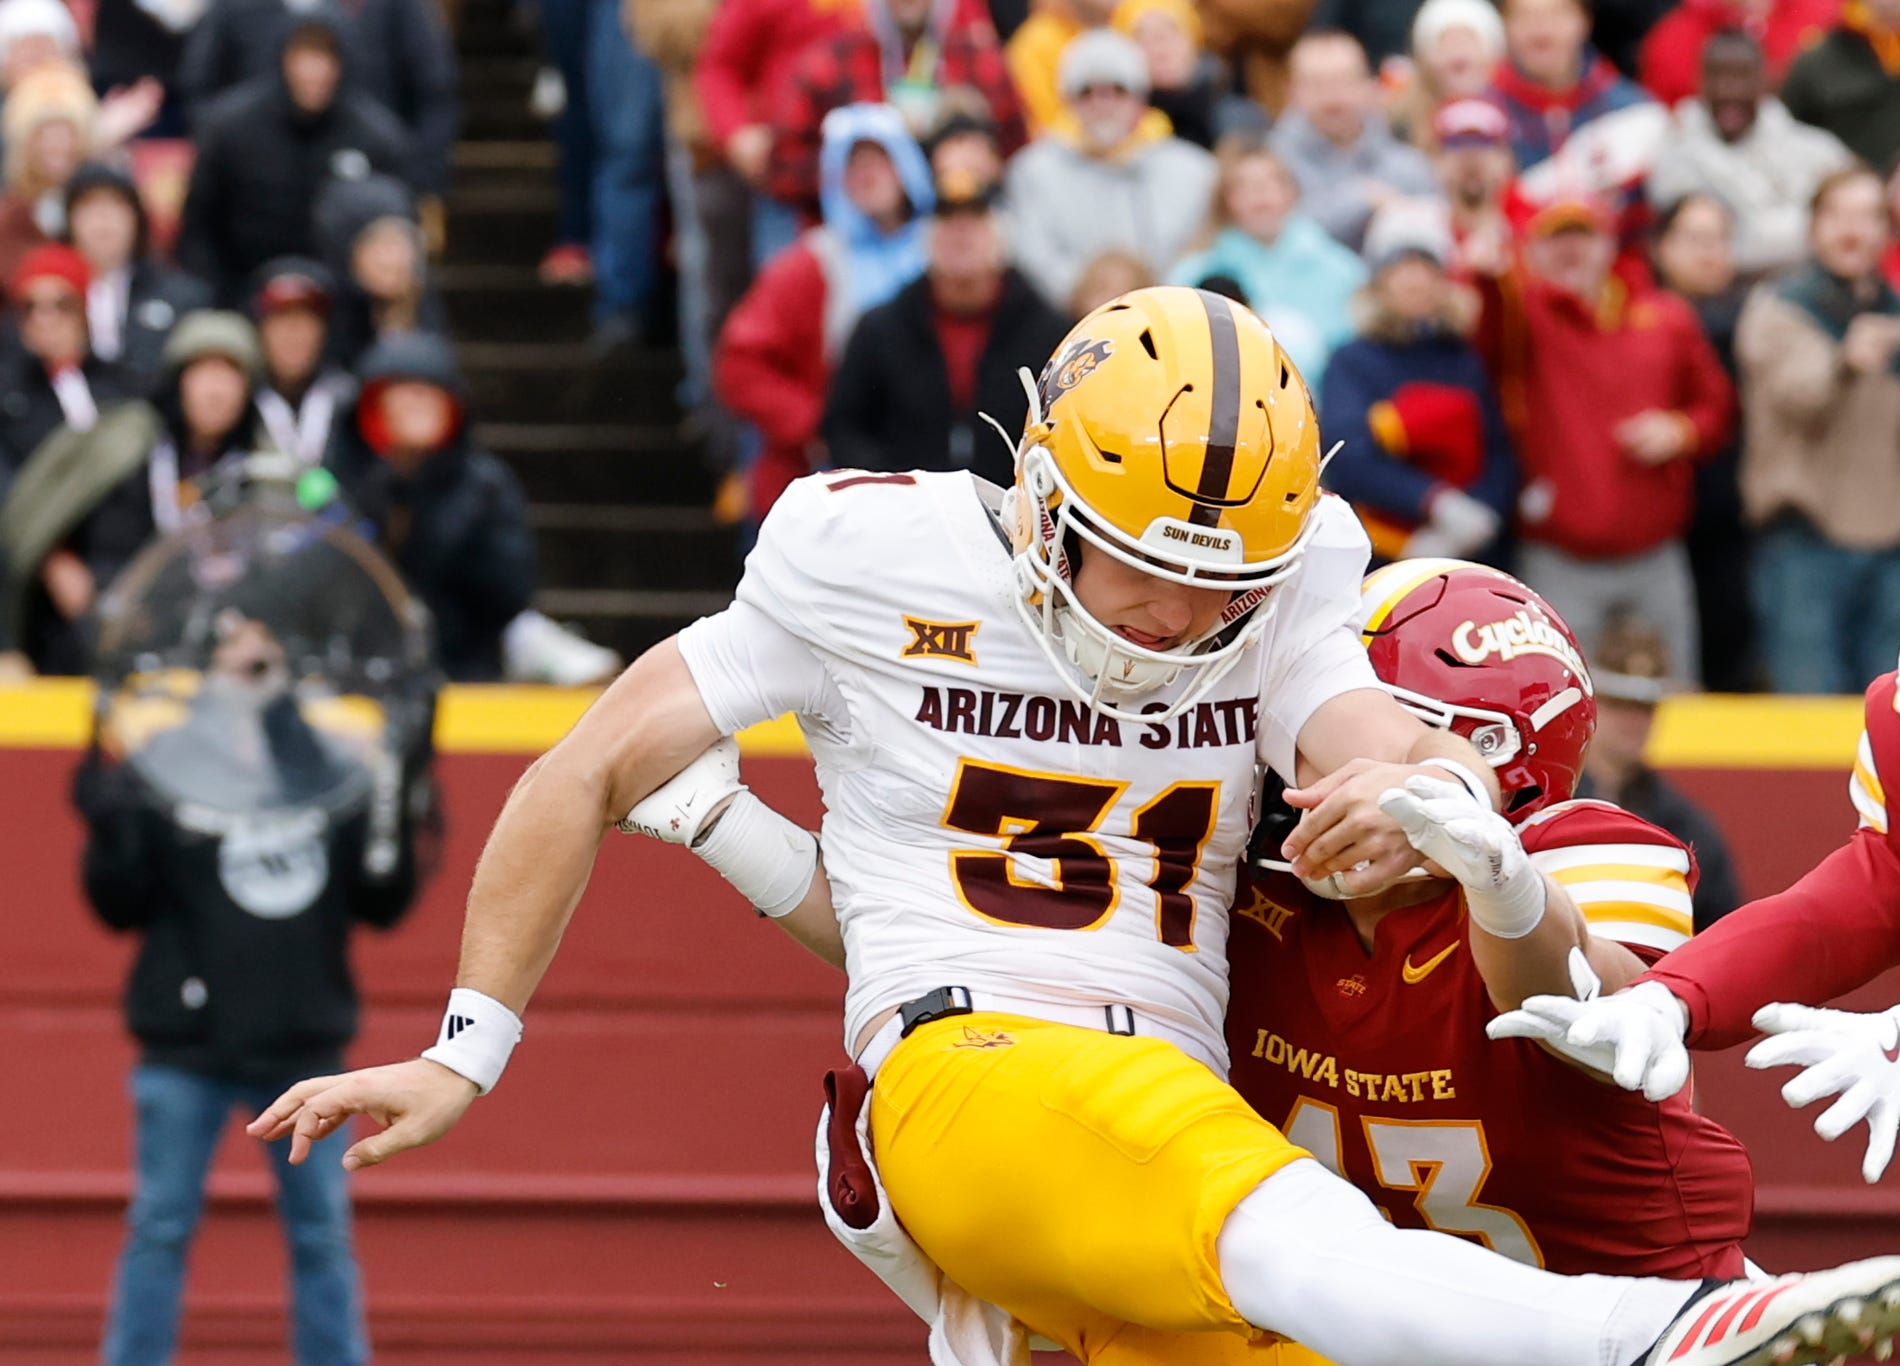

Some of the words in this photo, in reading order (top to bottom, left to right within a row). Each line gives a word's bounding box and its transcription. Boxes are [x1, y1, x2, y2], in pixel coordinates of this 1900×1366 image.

[1163, 525, 1190, 543] SUN
[1191, 533, 1232, 551] DEVILS
[900, 614, 982, 667] XII
[915, 686, 1123, 748] ARIZONA
[1139, 696, 1259, 750] STATE
[939, 755, 1223, 953] 31
[1238, 885, 1295, 943] XII
[1251, 1028, 1340, 1088] IOWA
[1344, 1069, 1456, 1103] STATE
